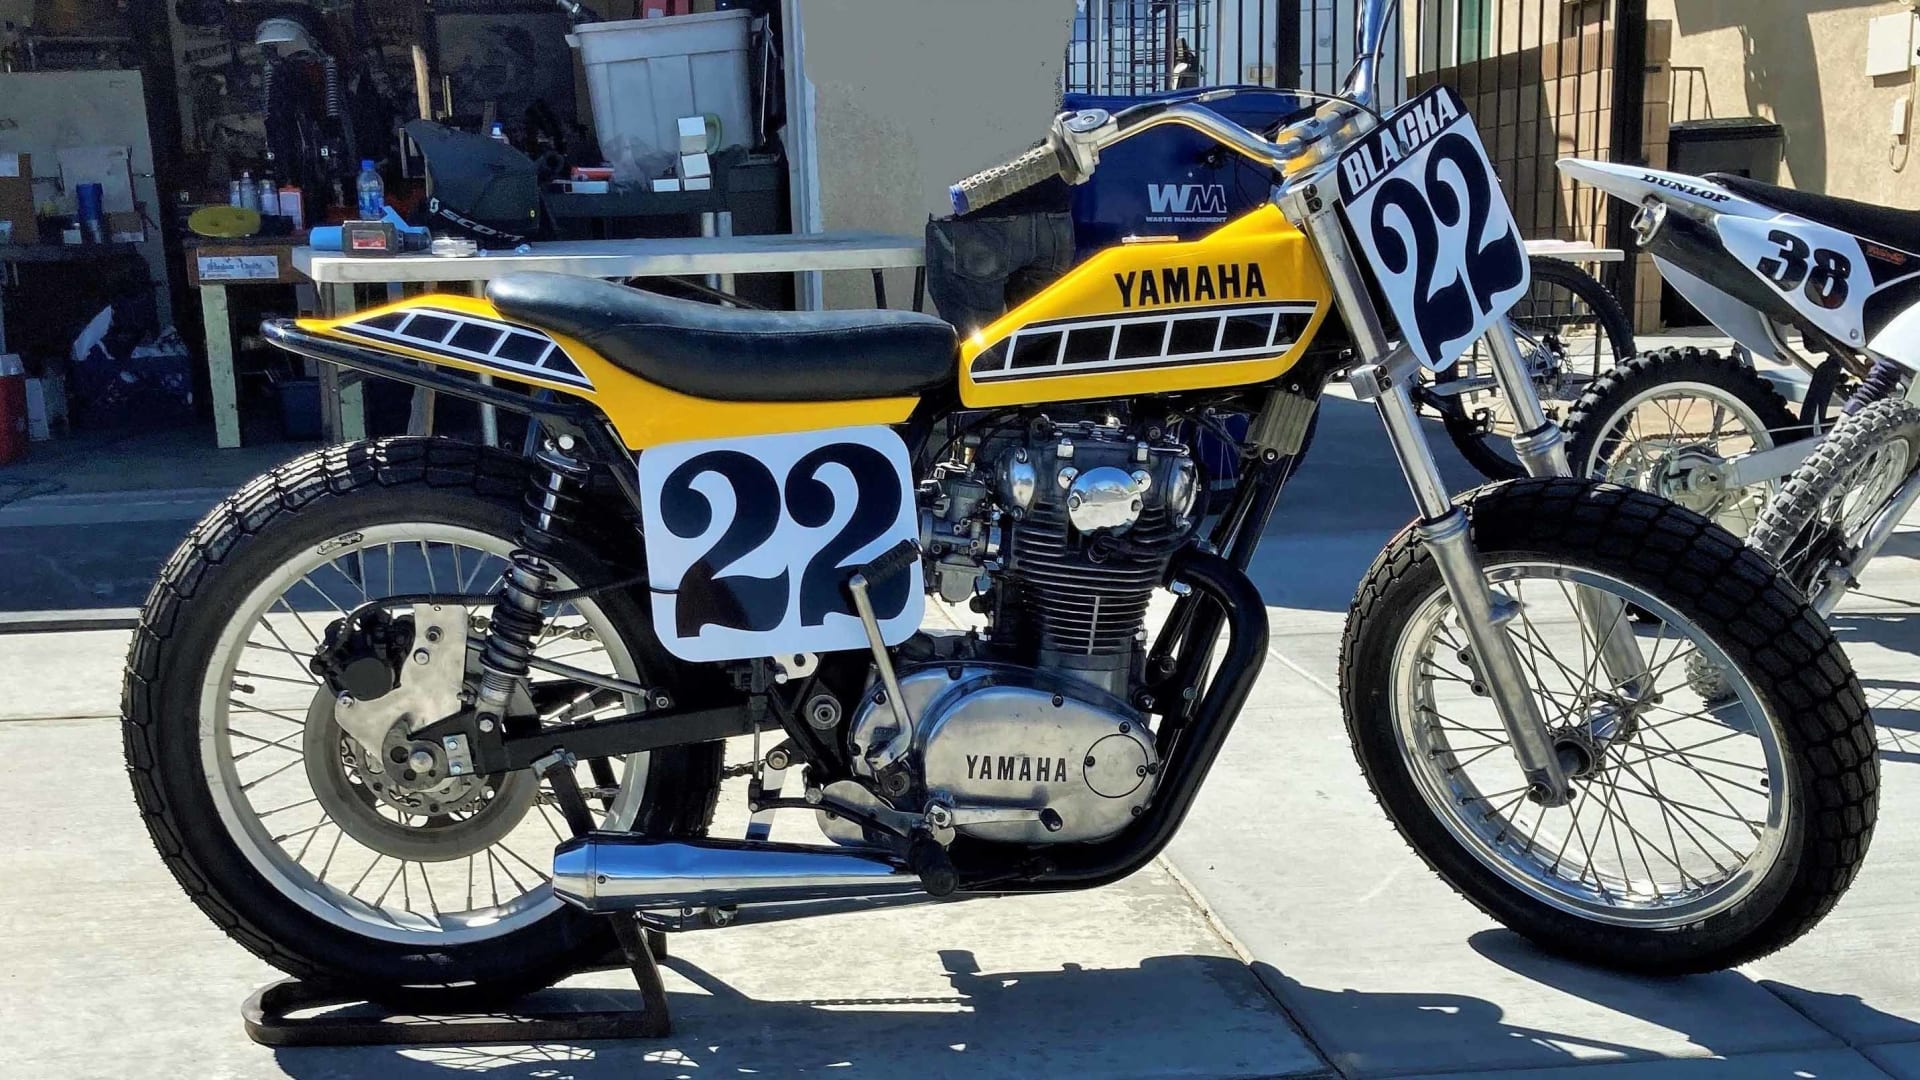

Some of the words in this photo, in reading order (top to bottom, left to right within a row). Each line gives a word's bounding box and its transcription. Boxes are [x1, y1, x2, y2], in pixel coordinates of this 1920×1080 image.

[1342, 87, 1459, 196] BLACKA
[1148, 184, 1227, 213] WM
[1640, 174, 1731, 203] DUNLOP
[1371, 133, 1525, 367] 22
[1757, 229, 1851, 309] 38
[1114, 262, 1266, 307] YAMAHA
[660, 442, 911, 638] 22
[966, 753, 1068, 783] YAMAHA
